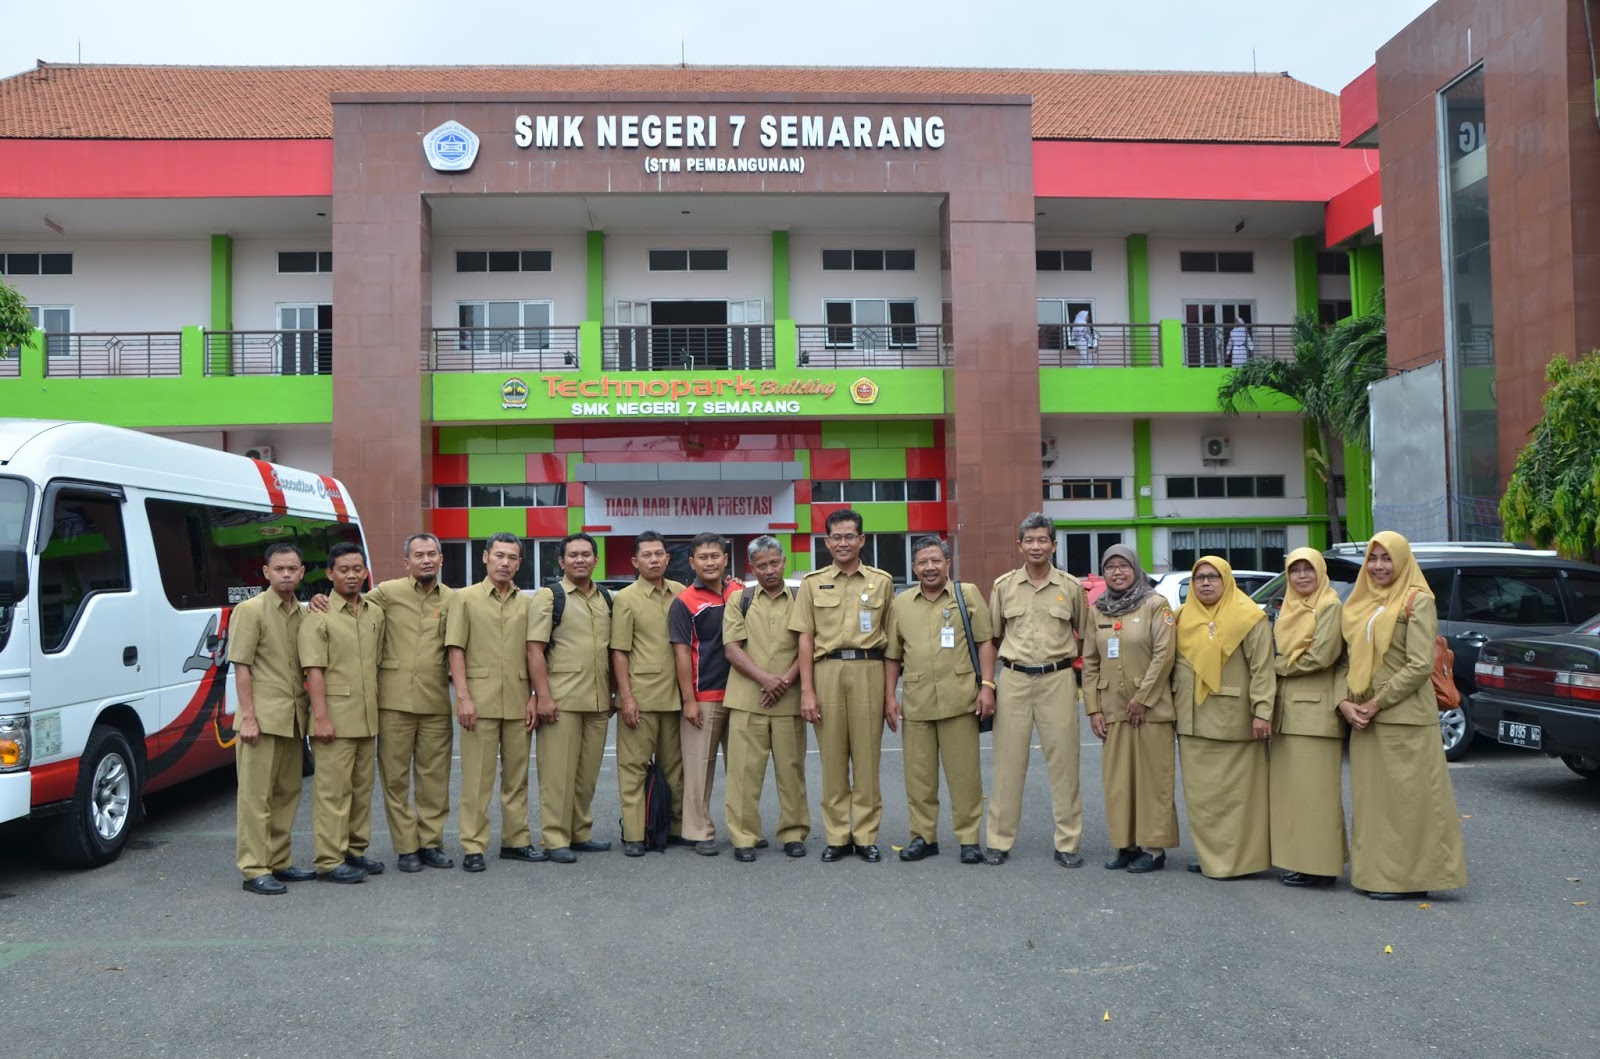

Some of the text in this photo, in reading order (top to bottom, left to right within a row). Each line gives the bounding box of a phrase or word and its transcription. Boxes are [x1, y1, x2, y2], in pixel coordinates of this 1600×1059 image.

[515, 115, 947, 148] SMK NEGERI 7 SEMARANG
[644, 156, 805, 174] (STM PEMBANGUNAN)
[541, 375, 757, 401] Technopark
[759, 379, 837, 399] Building
[570, 400, 801, 416] SMK NEGERI 7 SEMARANG
[605, 496, 772, 517] TIADA HARI TANPA PRESTASI
